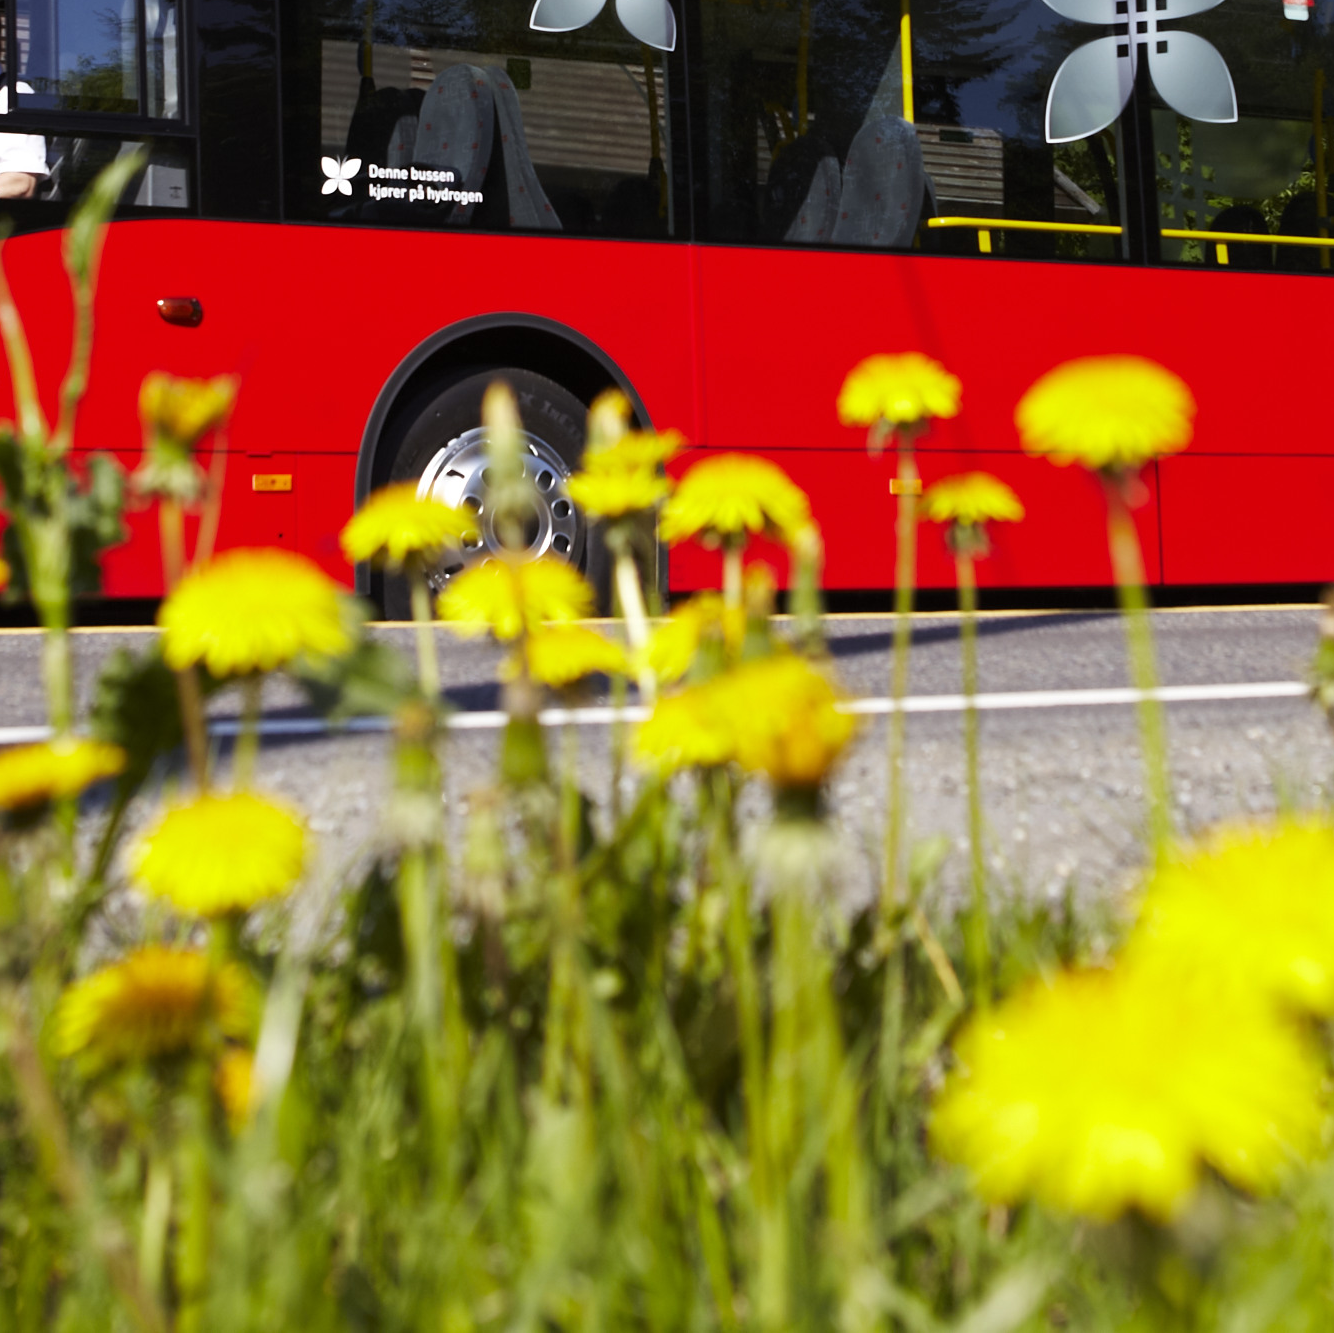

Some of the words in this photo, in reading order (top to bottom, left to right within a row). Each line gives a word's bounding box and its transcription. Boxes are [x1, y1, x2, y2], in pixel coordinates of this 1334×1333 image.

[368, 163, 408, 180] Denne
[410, 166, 455, 183] bussen
[368, 183, 407, 201] kjører
[408, 183, 425, 202] på
[426, 186, 484, 206] hydrogen
